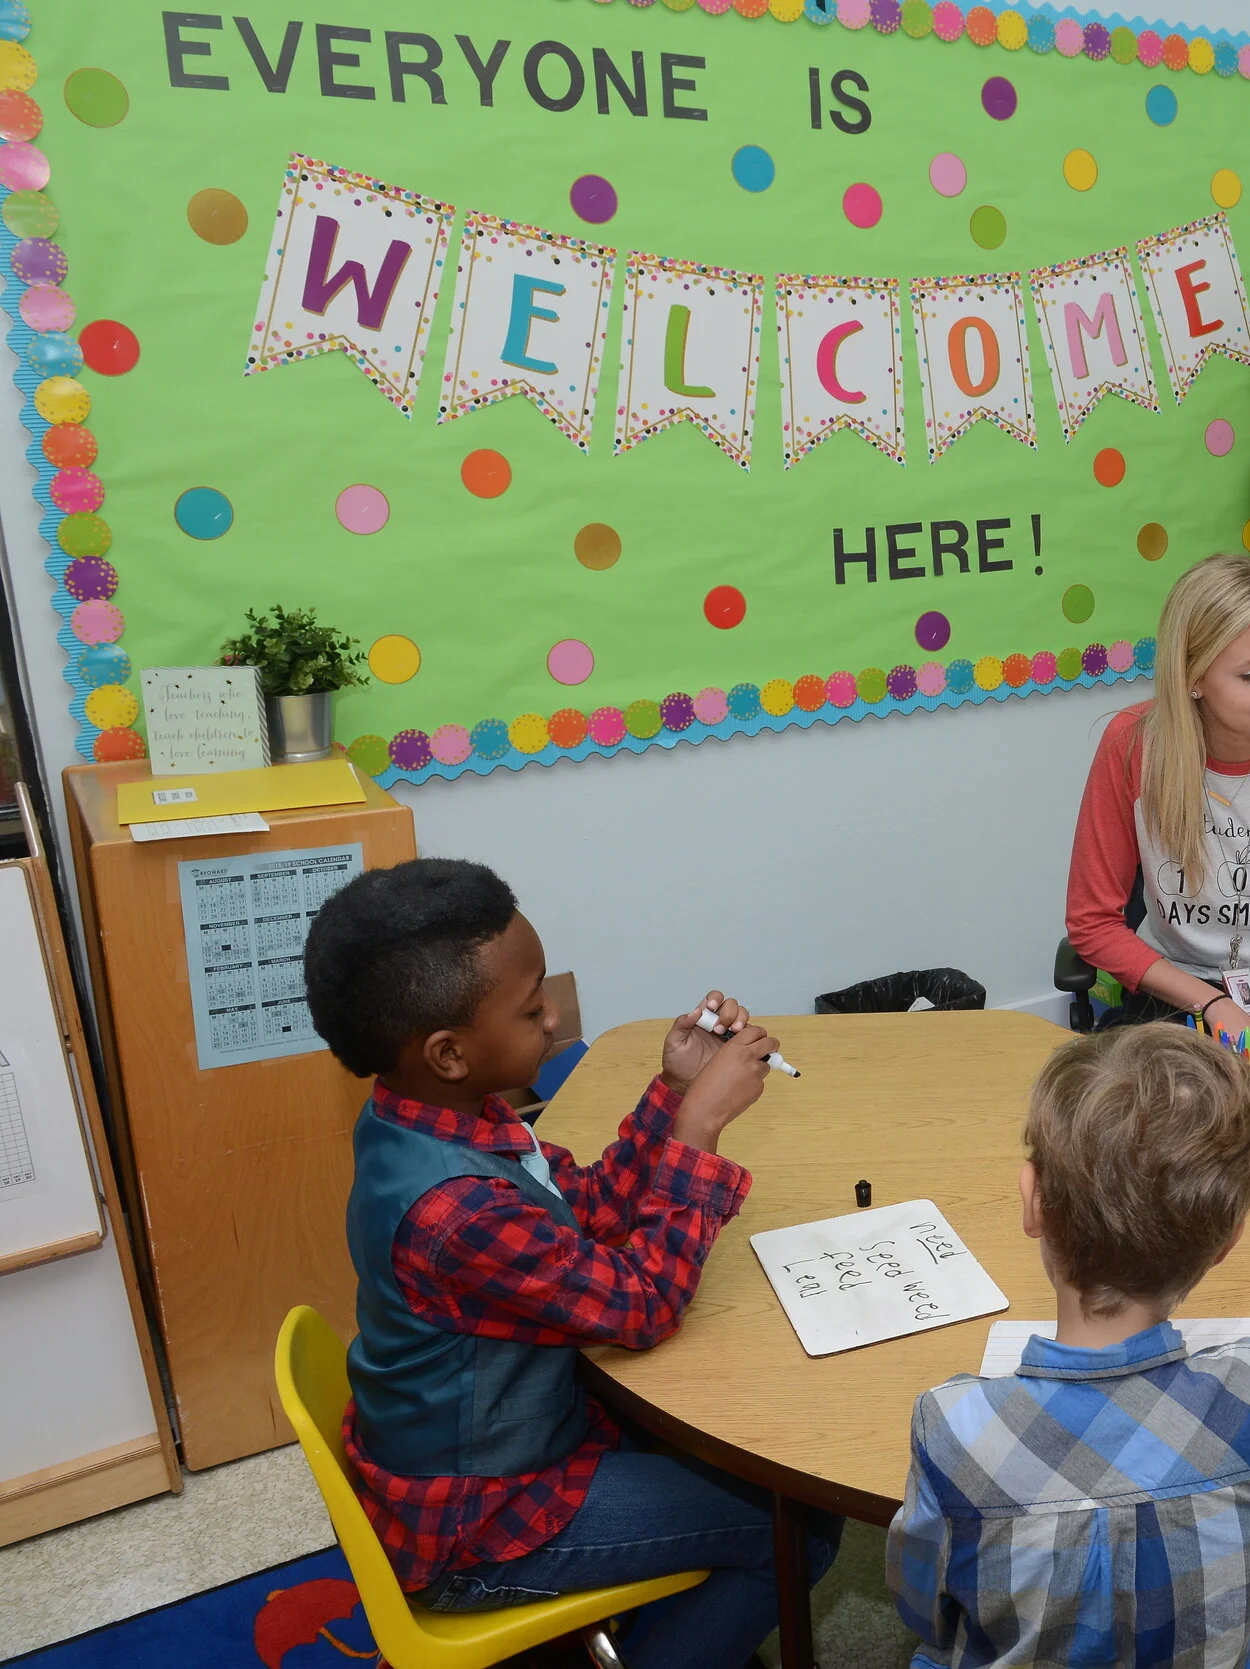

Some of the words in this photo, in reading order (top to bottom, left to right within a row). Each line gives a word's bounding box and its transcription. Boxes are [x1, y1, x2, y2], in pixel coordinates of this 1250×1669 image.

[162, 11, 709, 122] EVERYONE
[808, 67, 872, 135] IS
[160, 684, 212, 704] Teachers
[219, 688, 242, 699] who
[164, 707, 184, 722] love
[189, 726, 236, 741] children
[244, 728, 254, 738] to
[170, 746, 192, 760] love
[196, 744, 245, 760] learning
[318, 856, 350, 864] CALENDAR
[1157, 898, 1211, 926] DAYS
[909, 1221, 968, 1260] need
